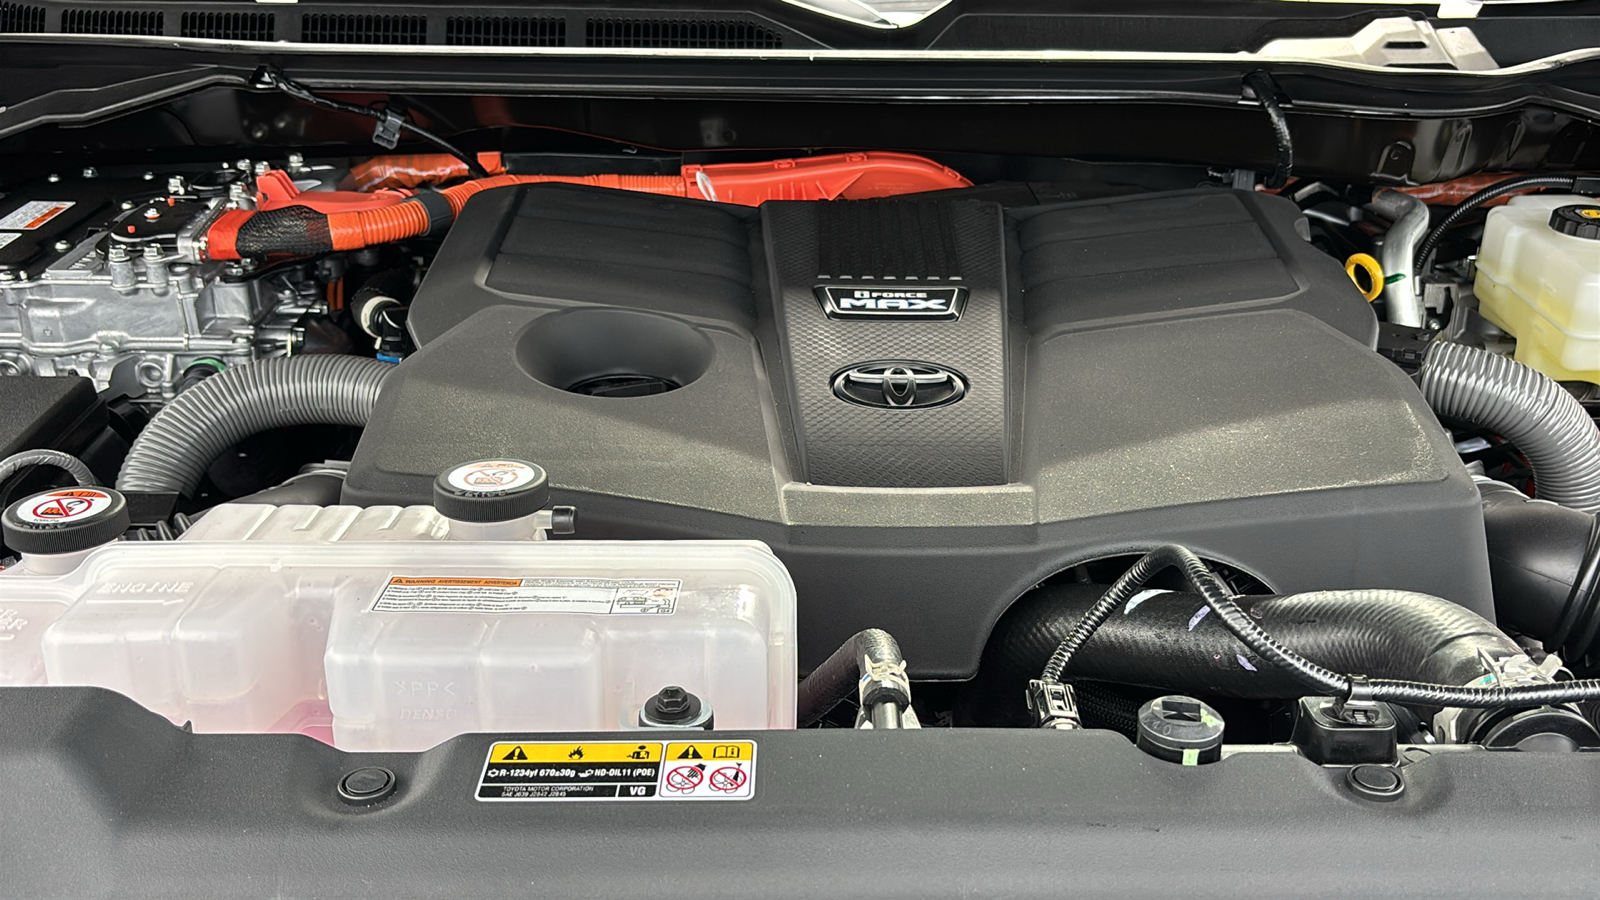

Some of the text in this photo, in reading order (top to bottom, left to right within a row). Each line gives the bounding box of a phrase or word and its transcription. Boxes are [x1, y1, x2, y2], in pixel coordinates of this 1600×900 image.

[840, 298, 948, 310] MAX
[96, 581, 194, 594] ENGINE
[400, 708, 458, 720] DENSO
[499, 768, 538, 778] R-1234yf
[594, 768, 631, 777] ND-OIL11
[632, 768, 655, 778] (POE)
[629, 786, 646, 796] VG
